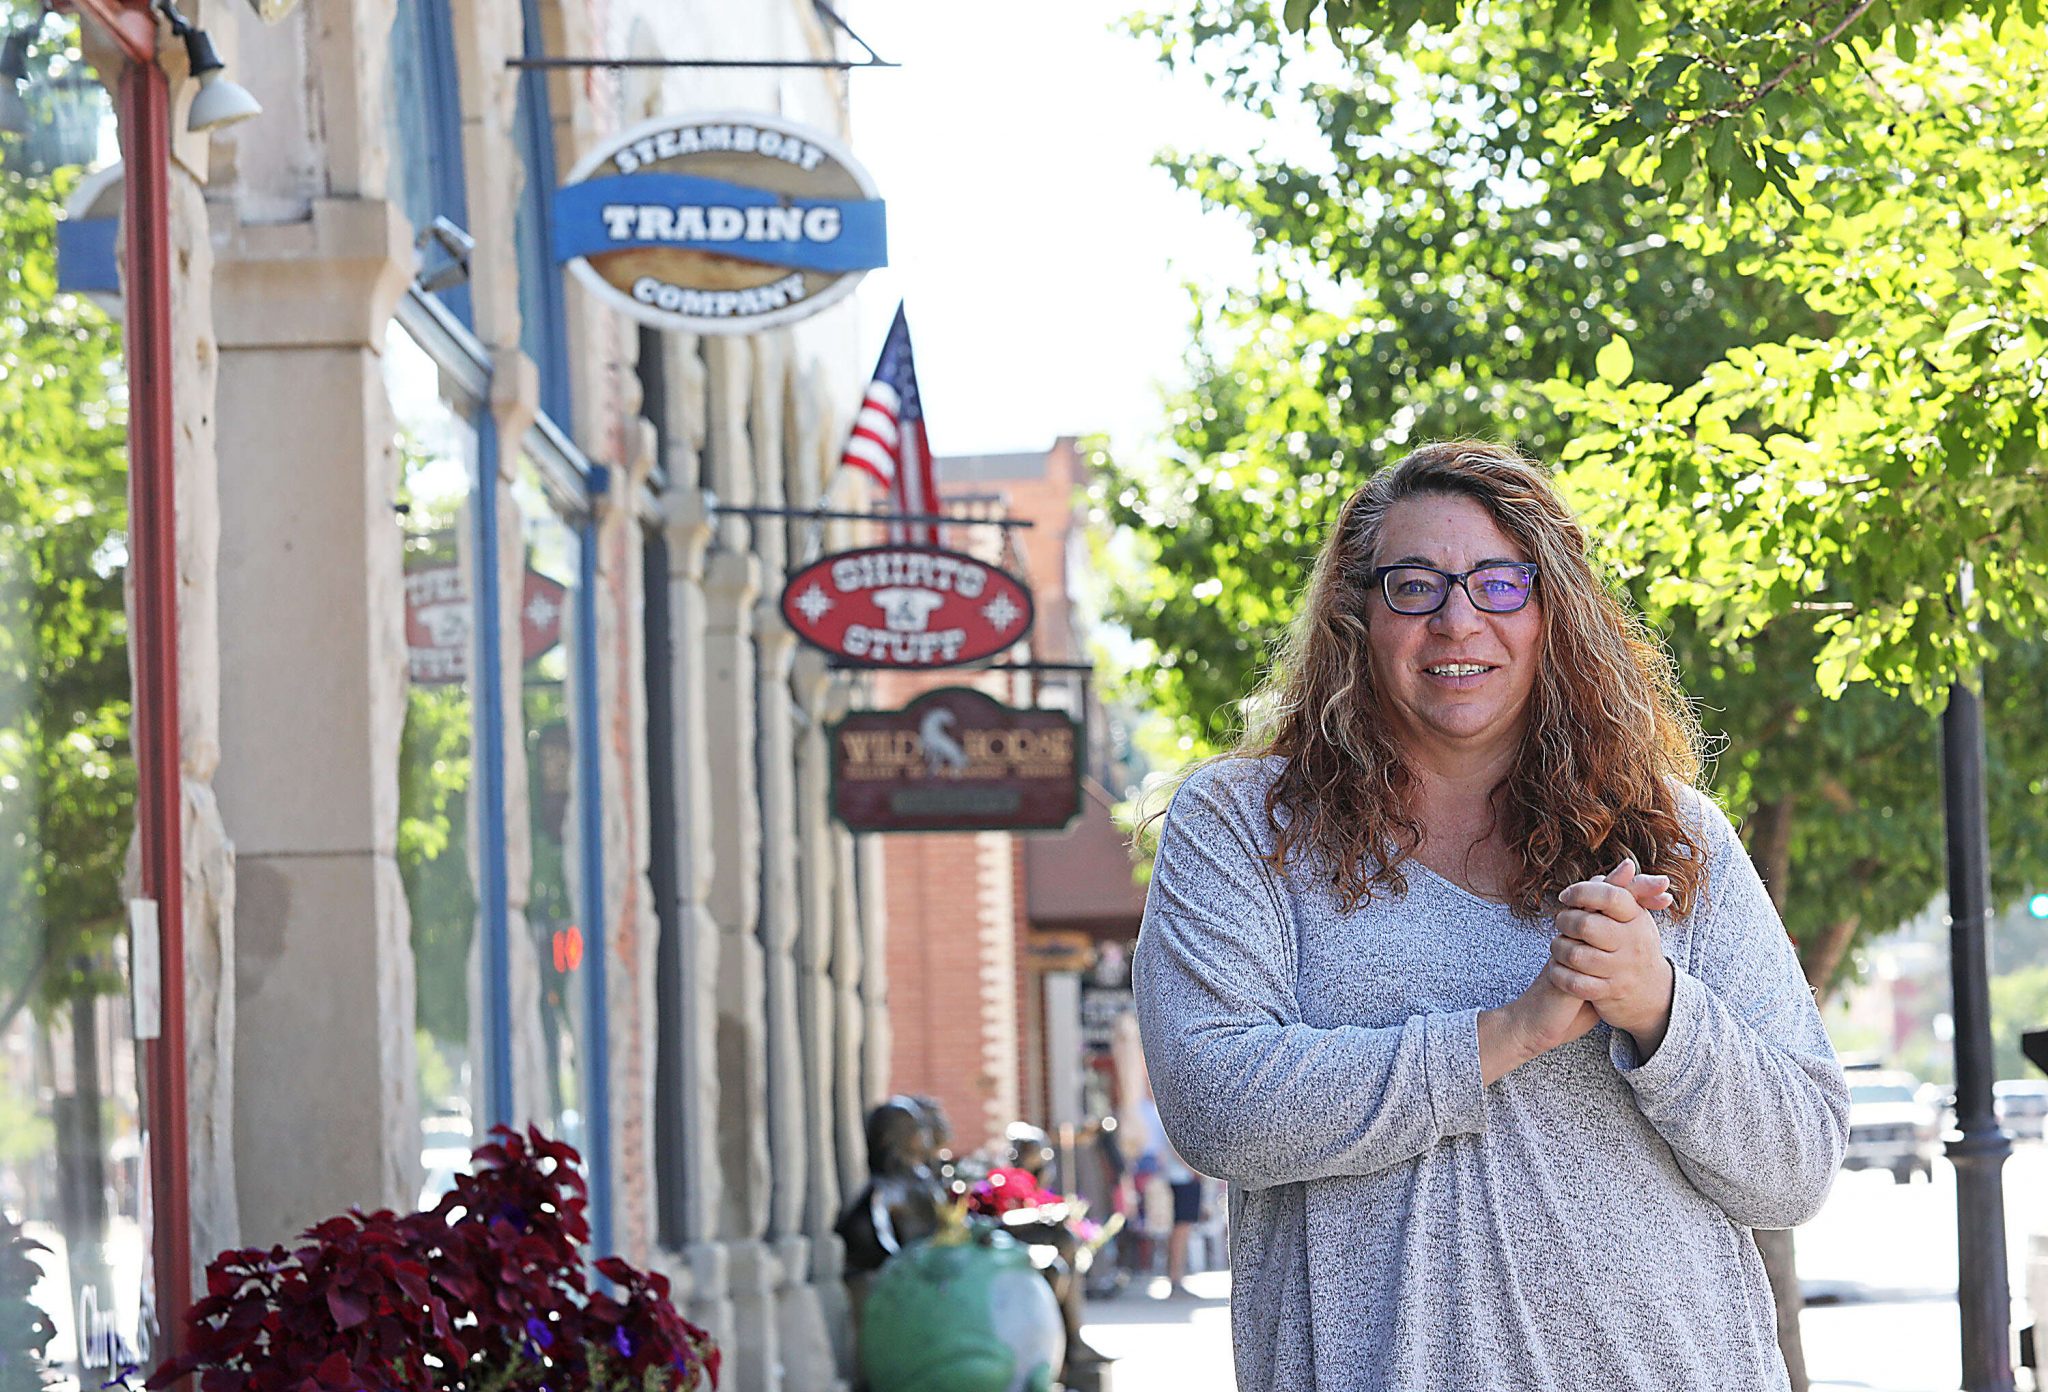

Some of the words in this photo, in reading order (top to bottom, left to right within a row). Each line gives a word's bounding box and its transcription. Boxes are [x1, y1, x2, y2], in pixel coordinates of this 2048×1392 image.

[614, 124, 823, 174] STEAMBOAT
[602, 204, 842, 243] TRADING
[633, 274, 805, 316] COMPANY
[831, 553, 987, 598] SHIRTS
[843, 625, 965, 663] STUFF
